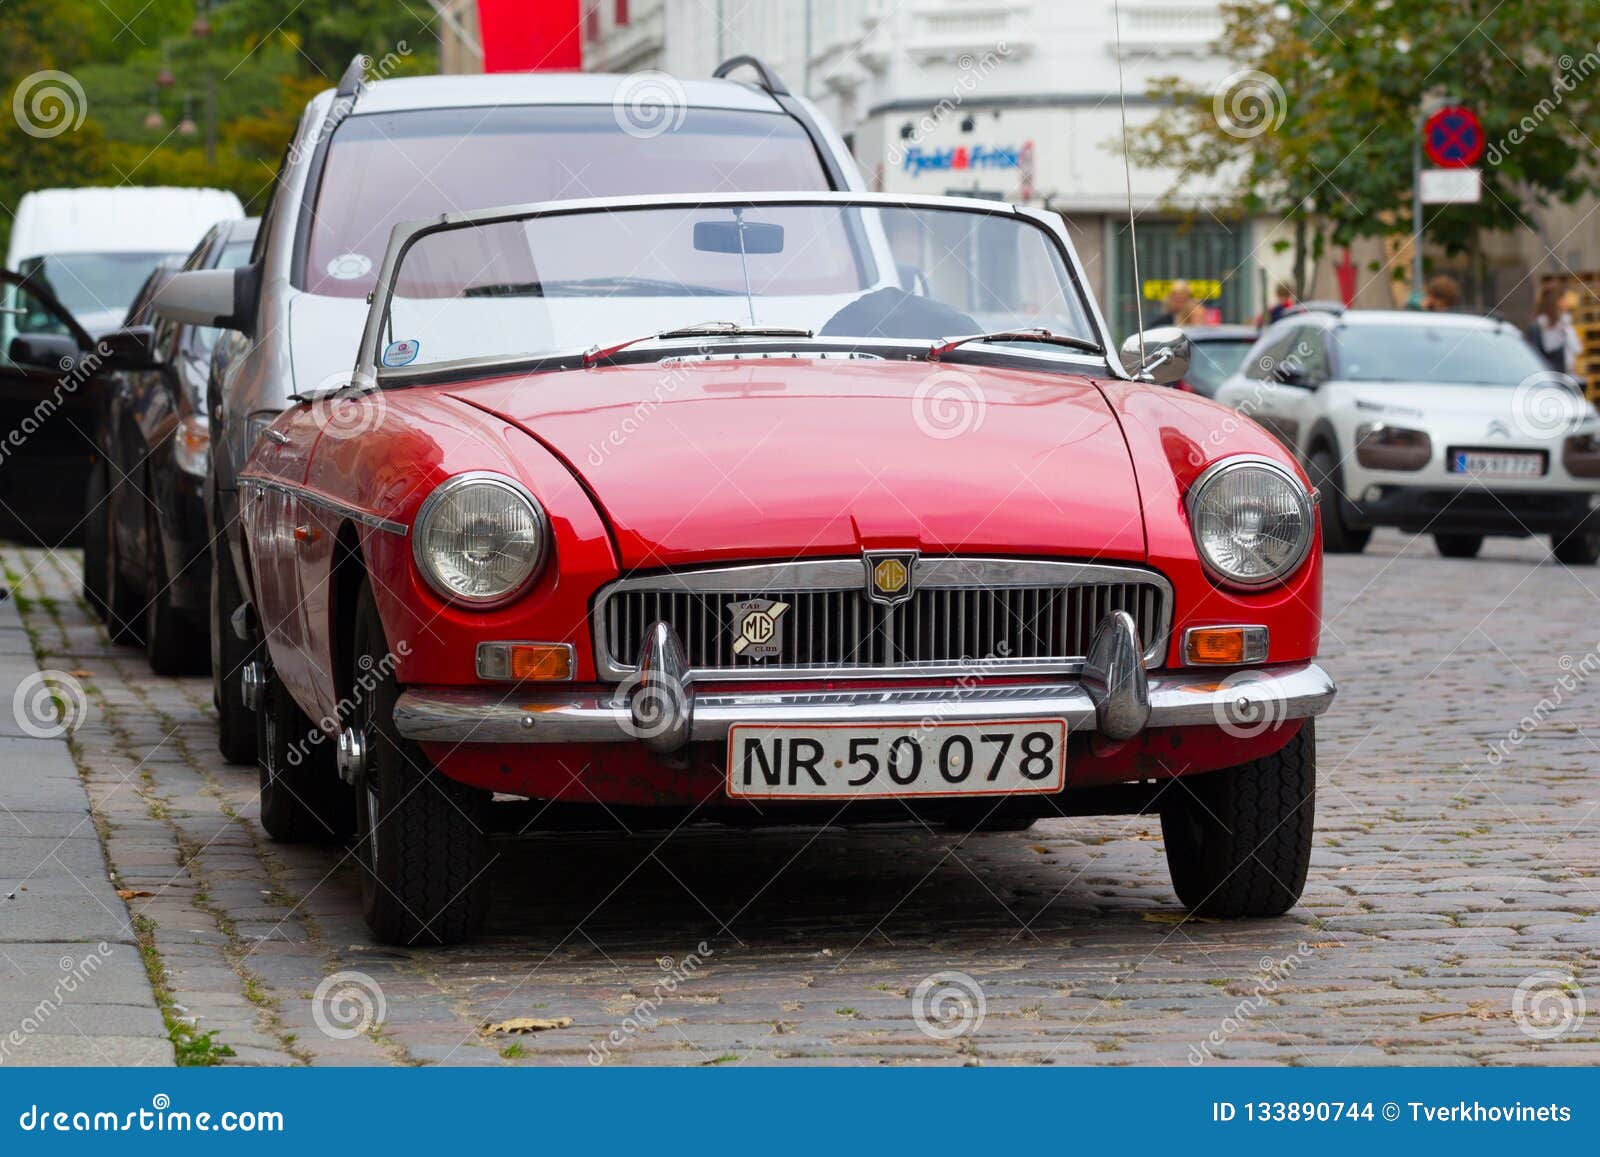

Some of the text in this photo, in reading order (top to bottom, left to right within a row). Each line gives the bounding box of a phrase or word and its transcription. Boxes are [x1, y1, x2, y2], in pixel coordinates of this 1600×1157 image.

[878, 561, 904, 589] MG
[745, 615, 771, 640] MG
[743, 731, 1054, 786] NR 50 078
